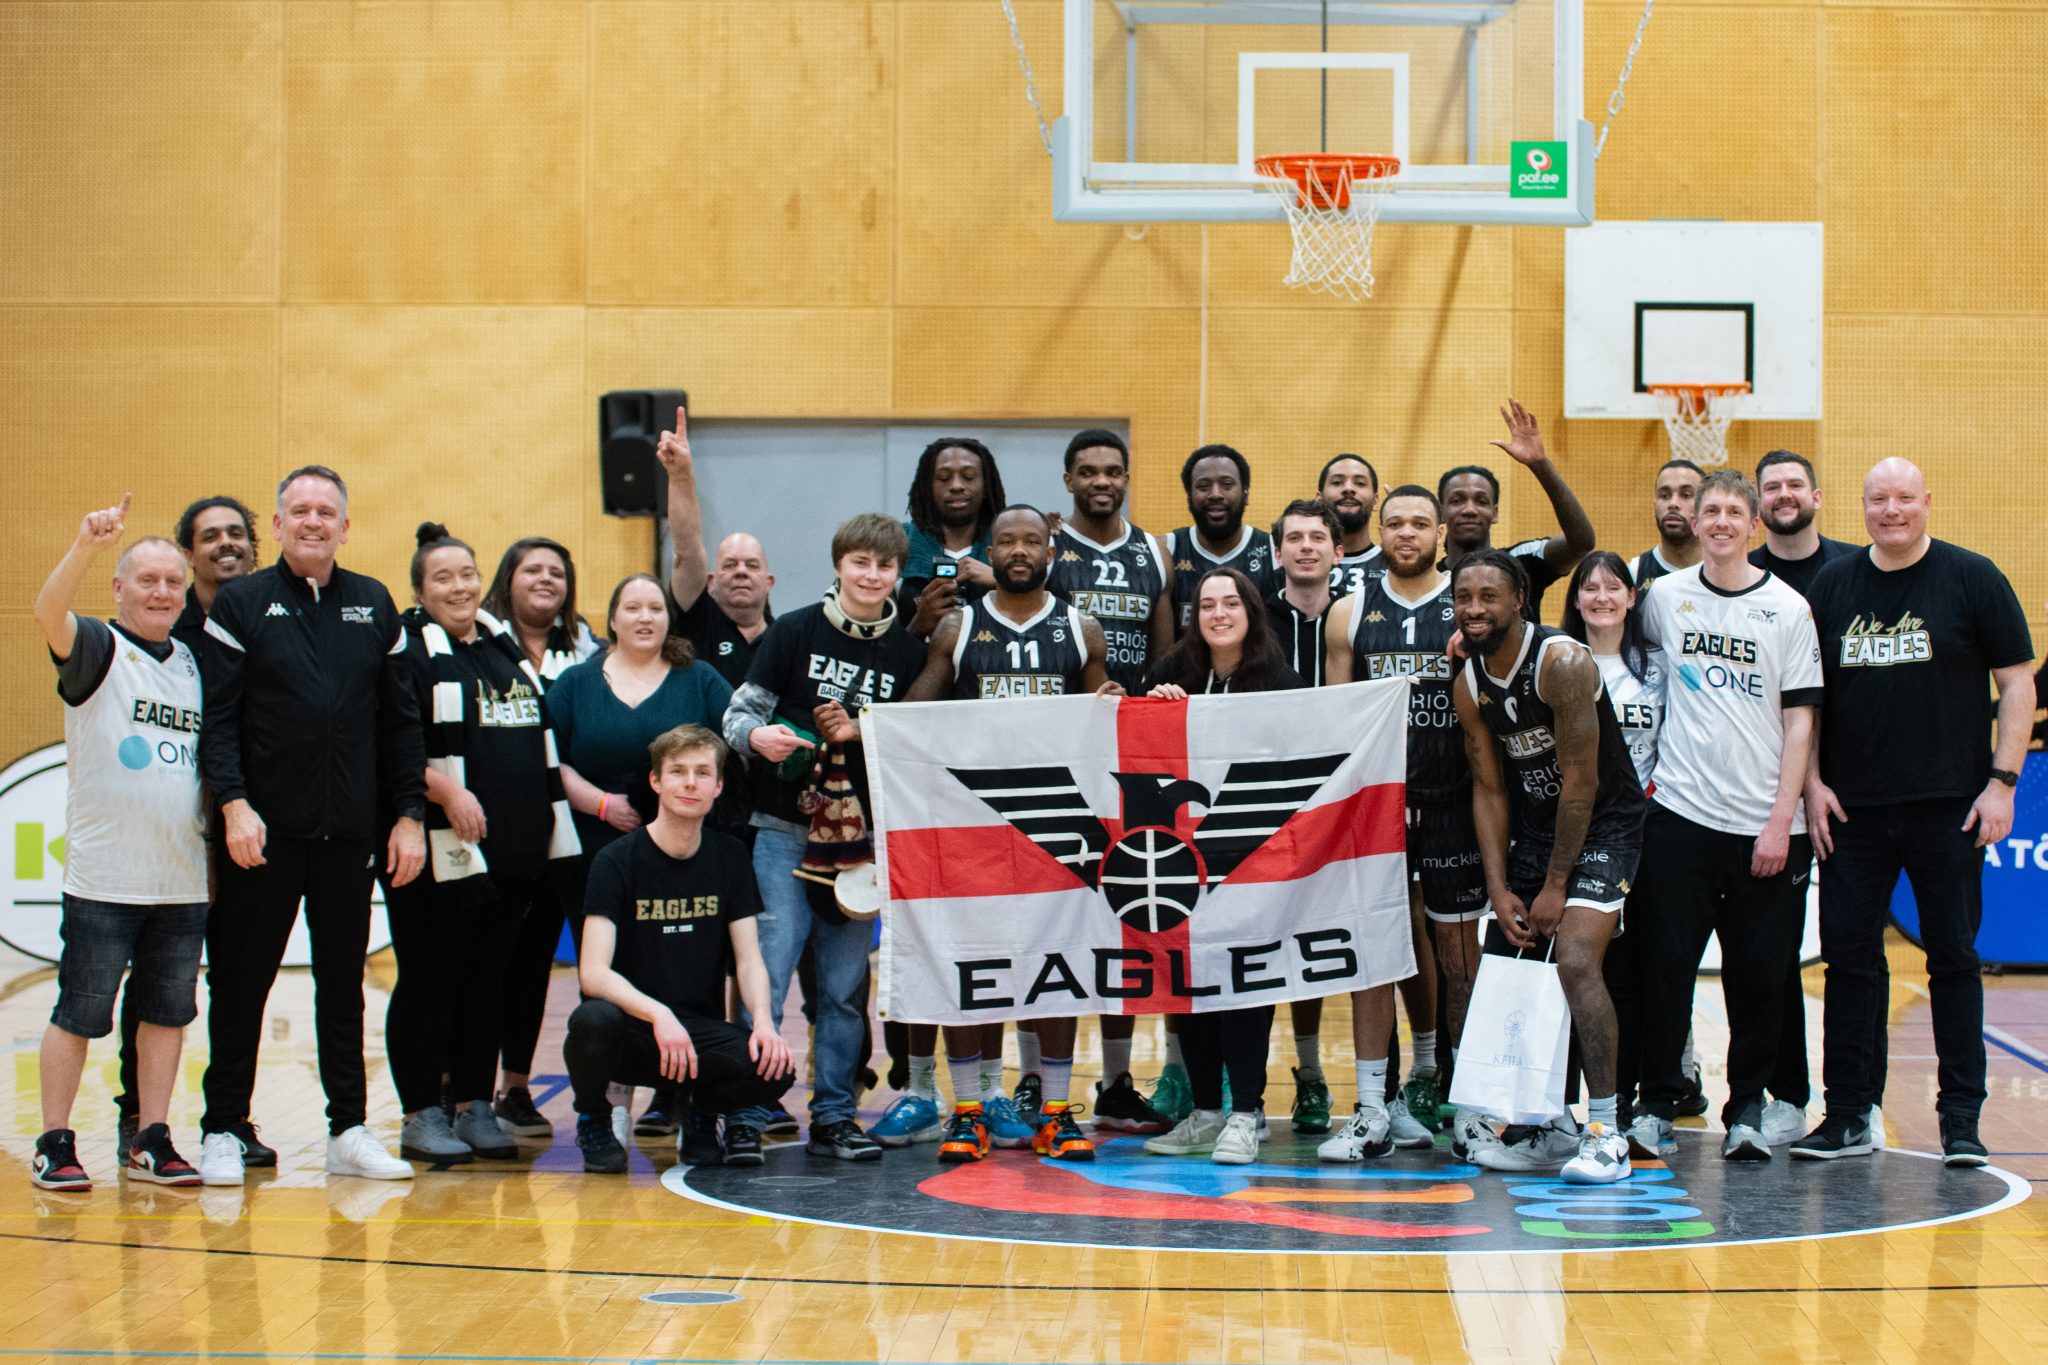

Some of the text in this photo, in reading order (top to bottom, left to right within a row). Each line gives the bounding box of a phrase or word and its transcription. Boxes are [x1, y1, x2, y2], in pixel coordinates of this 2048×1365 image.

[1092, 560, 1129, 588] 22
[1330, 567, 1365, 592] 23
[1073, 593, 1151, 620] EAGLES
[1402, 616, 1416, 645] 1
[1846, 610, 1924, 636] We Are
[1104, 629, 1148, 650] ERIÖS
[1681, 632, 1757, 664] EAGLES
[1842, 632, 1931, 665] EAGLES
[1006, 640, 1040, 669] 11
[1105, 647, 1146, 665] ROUP
[1367, 653, 1451, 679] EAGLES
[504, 678, 532, 701] Are
[981, 675, 1063, 700] EAGLES
[1706, 665, 1763, 698] ONE
[479, 698, 541, 725] EAGLES
[1411, 689, 1457, 711] RIÖ
[132, 698, 201, 735] EAGLES
[1406, 710, 1459, 728] ROUP
[157, 740, 199, 768] ON
[1422, 848, 1481, 868] muckle
[636, 895, 719, 920] EAGLES
[954, 927, 1359, 1011] EAGLES
